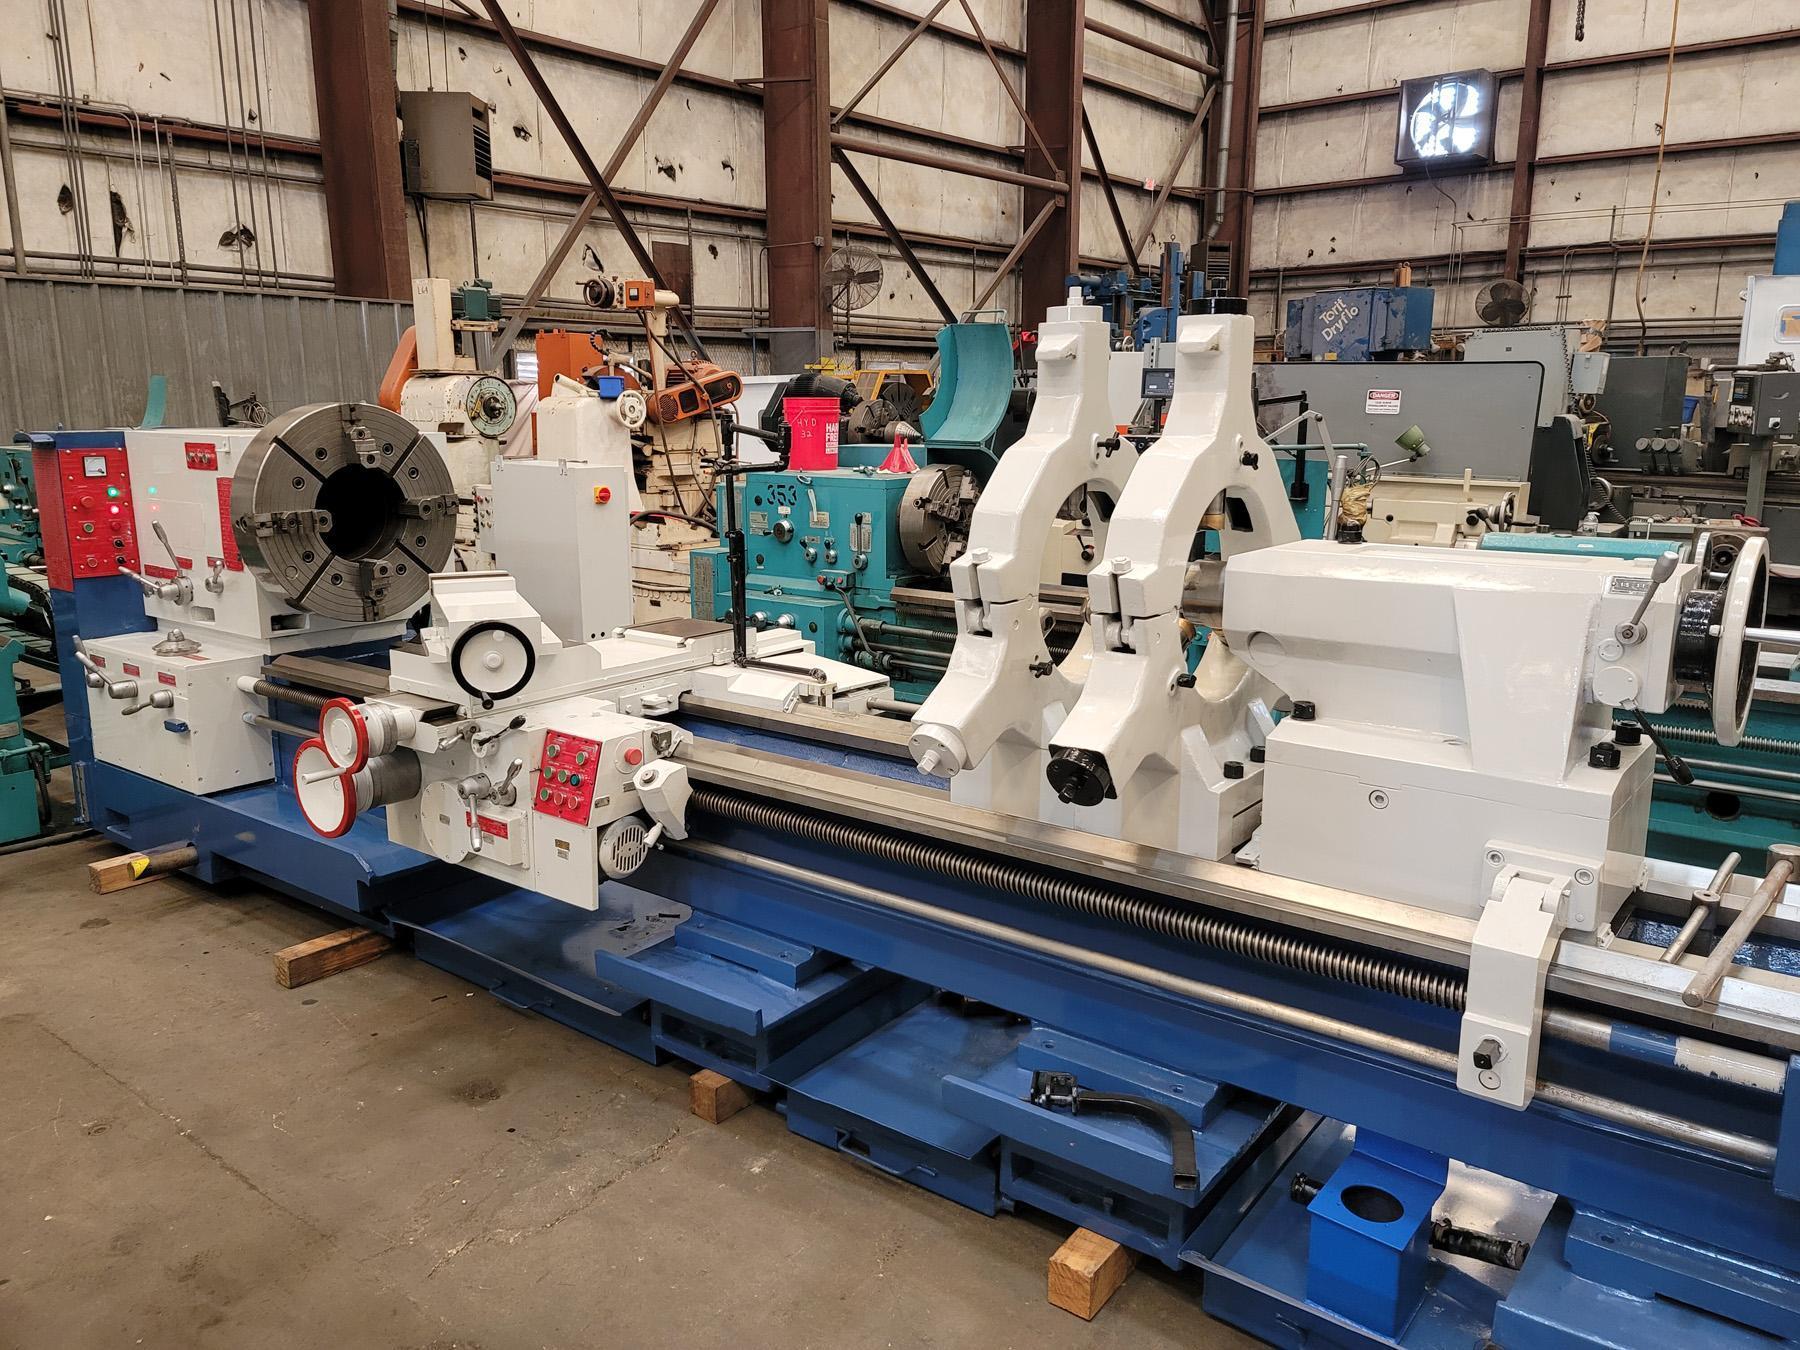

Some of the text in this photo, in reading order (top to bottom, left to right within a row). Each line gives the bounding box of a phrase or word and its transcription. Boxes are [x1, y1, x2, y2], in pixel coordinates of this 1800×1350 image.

[1319, 297, 1346, 324] Torit
[1322, 307, 1359, 341] Dryflo
[766, 484, 797, 506] 353
